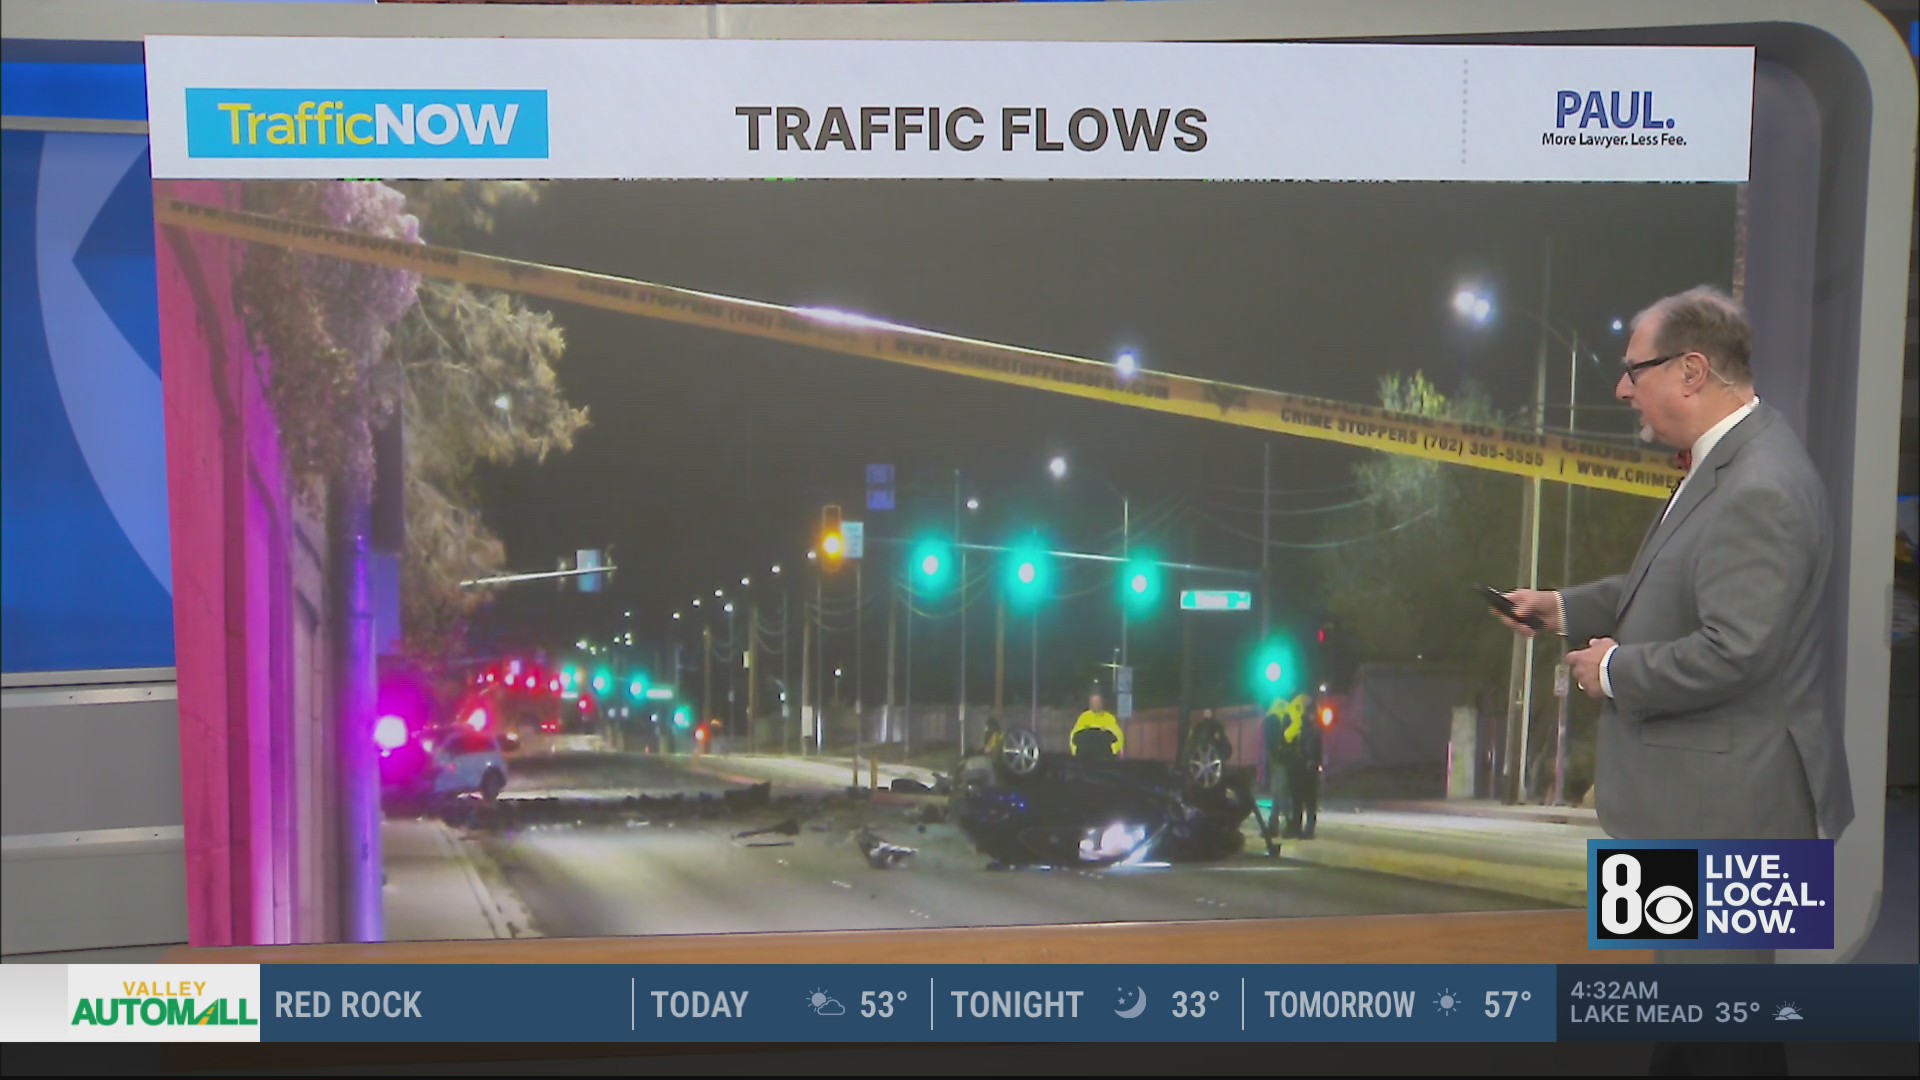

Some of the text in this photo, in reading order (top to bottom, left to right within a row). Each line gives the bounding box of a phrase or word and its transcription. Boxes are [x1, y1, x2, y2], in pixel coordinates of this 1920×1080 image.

[217, 101, 519, 146] TrafficNOW
[735, 106, 1208, 153] TRAFFIC FLOWS
[1556, 90, 1675, 129] PAUL.
[1542, 133, 1687, 149] More Lawyer. Less Fee.
[1281, 408, 1332, 430] CRIME
[1338, 417, 1418, 445] STOPPERS
[1424, 434, 1463, 457] (702)
[1470, 441, 1544, 467] 385-5555
